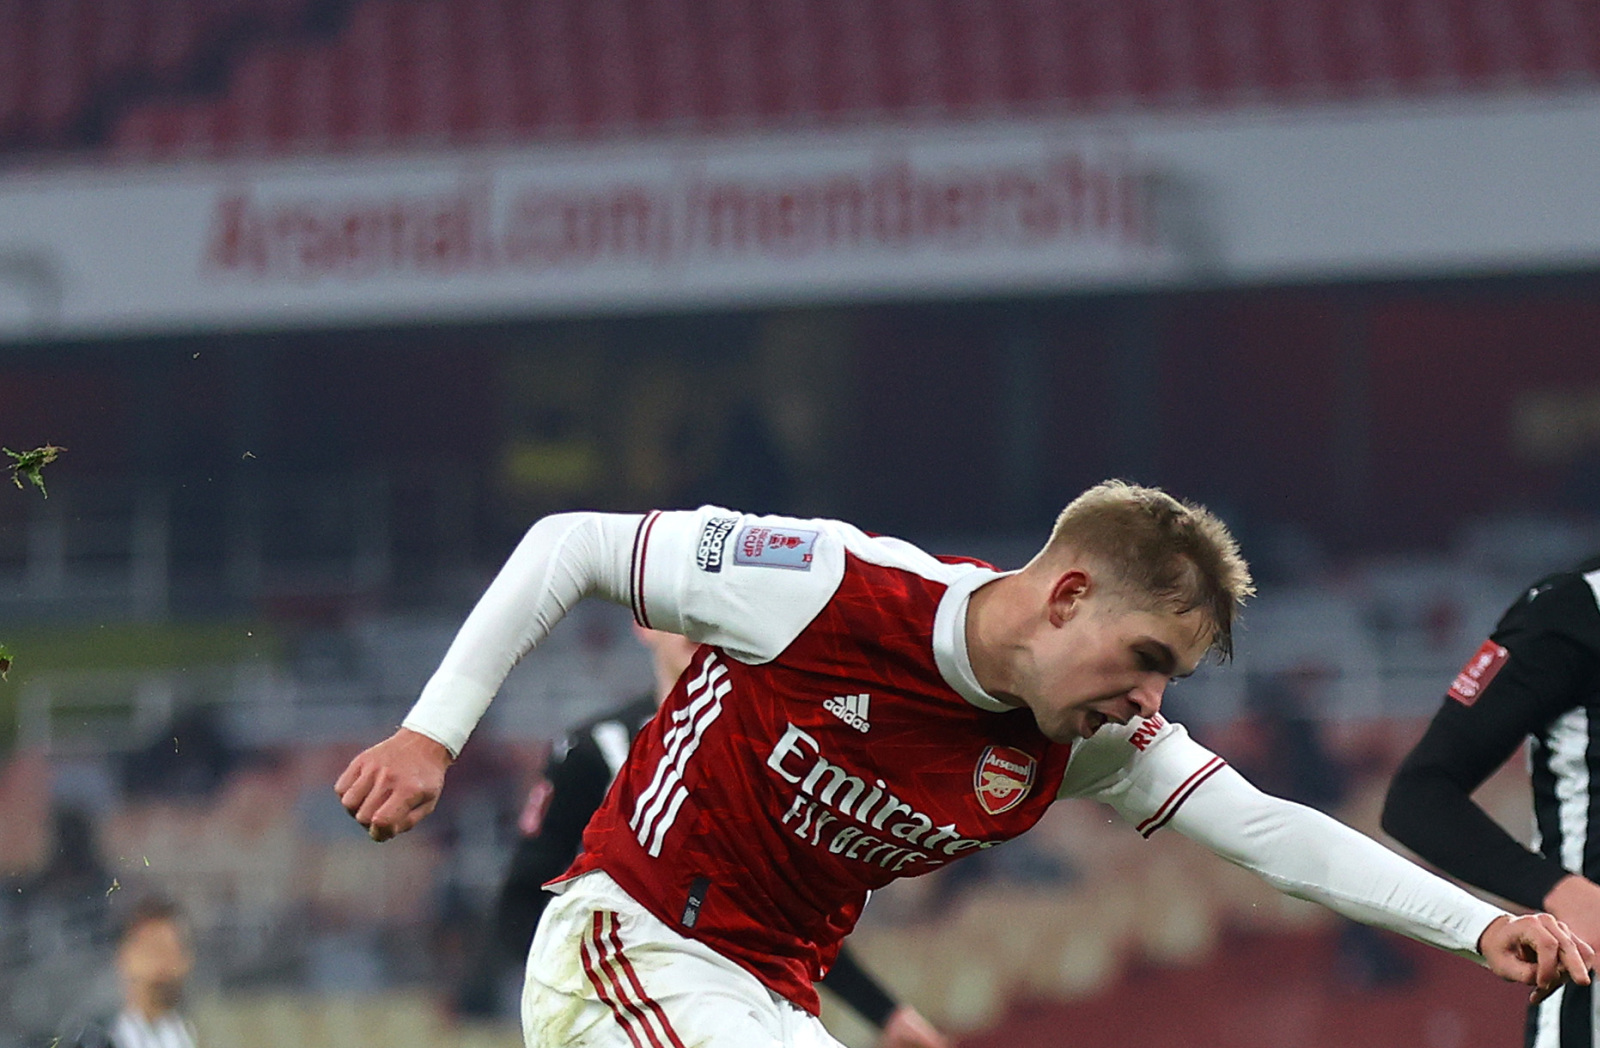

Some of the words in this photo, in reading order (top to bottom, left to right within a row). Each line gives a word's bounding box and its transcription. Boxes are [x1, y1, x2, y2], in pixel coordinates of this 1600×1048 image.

[822, 699, 871, 733] adidas
[986, 754, 1030, 776] Arsenal
[782, 795, 838, 846] FLY
[828, 826, 943, 872] BETTE
